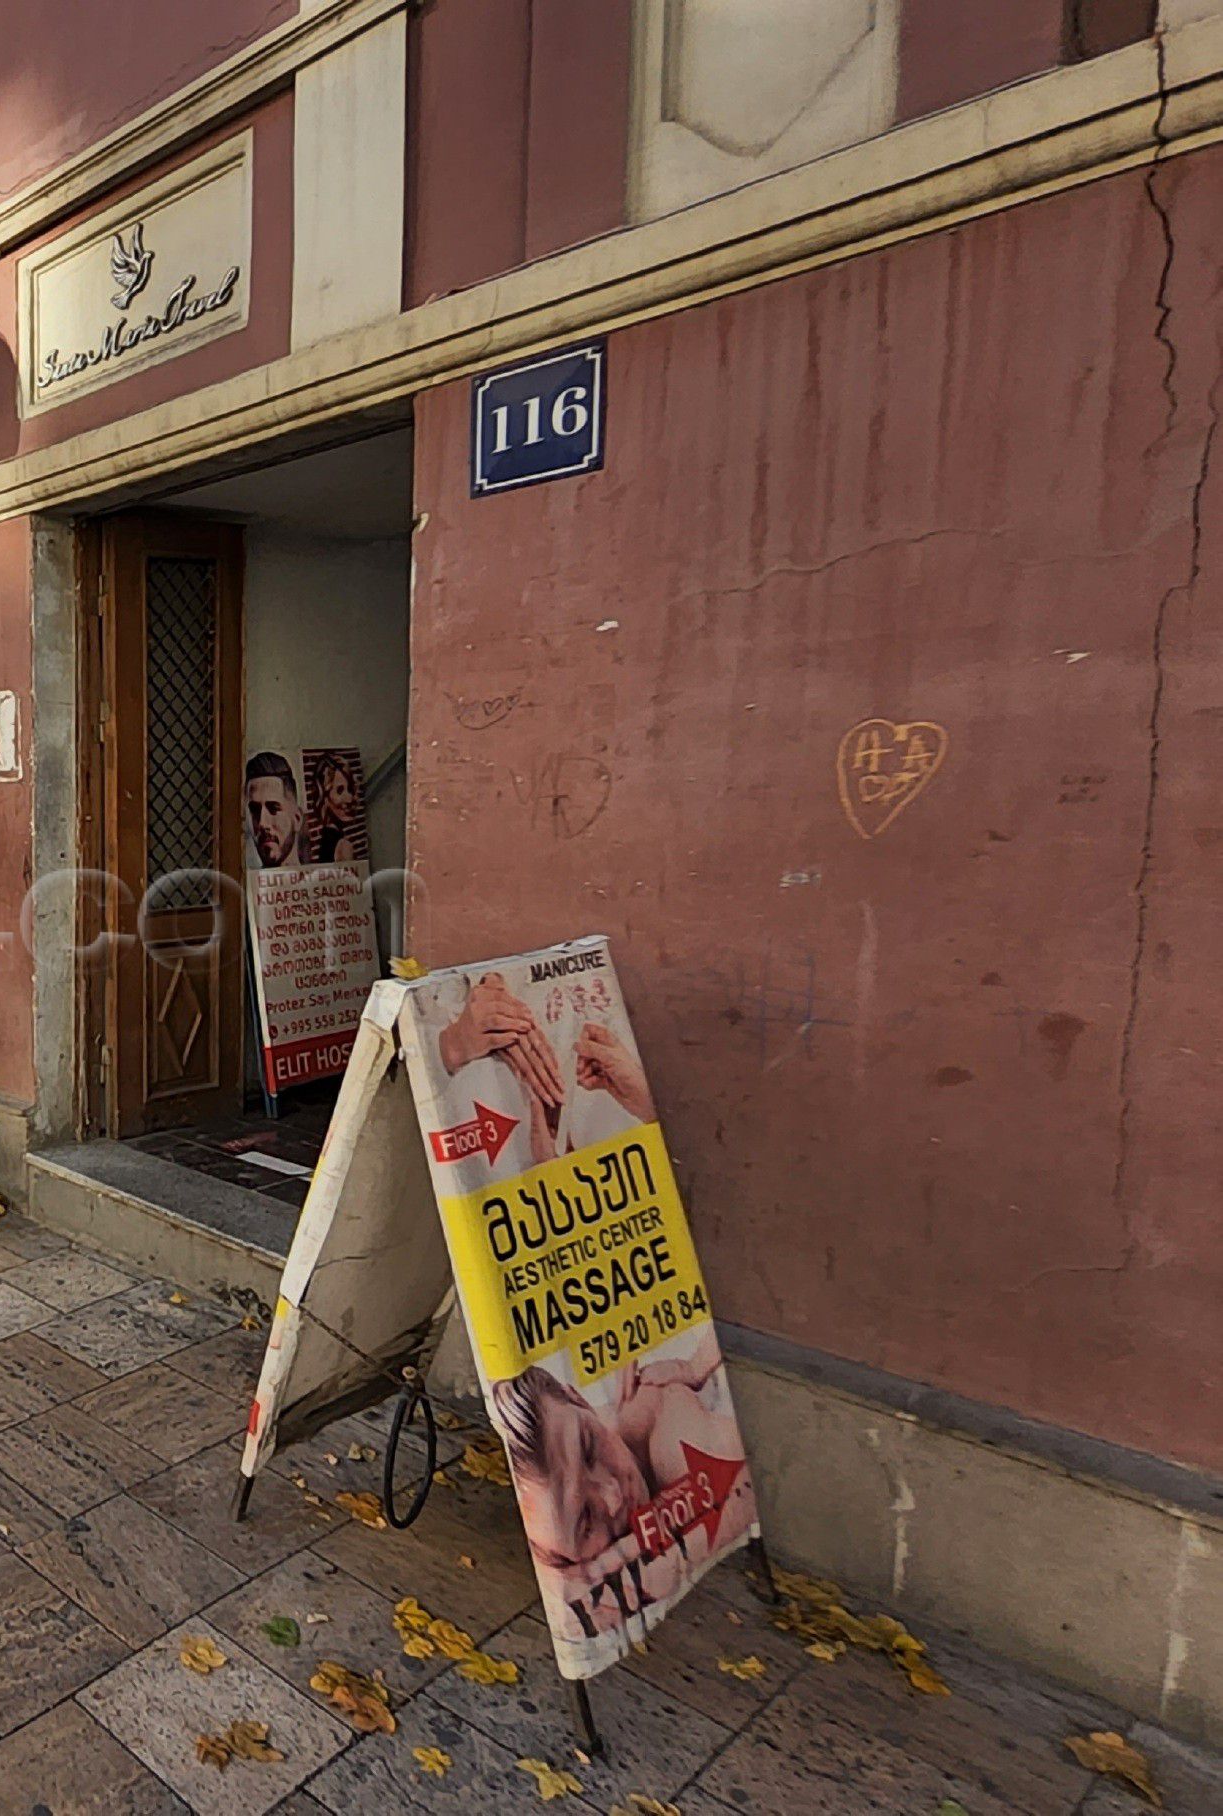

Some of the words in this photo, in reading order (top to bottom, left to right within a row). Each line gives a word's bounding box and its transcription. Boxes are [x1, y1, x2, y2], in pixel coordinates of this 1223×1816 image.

[490, 386, 588, 455] 116
[259, 873, 284, 888] ELIT
[313, 881, 363, 899] SALONU
[257, 920, 315, 941] სალონი
[270, 942, 290, 956] და
[530, 950, 607, 983] MANICURE
[266, 998, 304, 1015] Protez
[283, 1017, 311, 1035] +995
[276, 1051, 311, 1081] ELIT
[438, 1125, 482, 1159] Floor
[484, 1120, 498, 1142] 3
[482, 1143, 657, 1262] მასაჟი
[503, 1234, 597, 1299] AESTHETIC
[599, 1205, 664, 1252] CENTER
[511, 1235, 677, 1355] MASSAGE
[580, 1329, 620, 1375] 579
[623, 1314, 650, 1352] 20
[652, 1299, 677, 1334] 18
[677, 1284, 707, 1321] 84
[697, 1472, 714, 1509] 3
